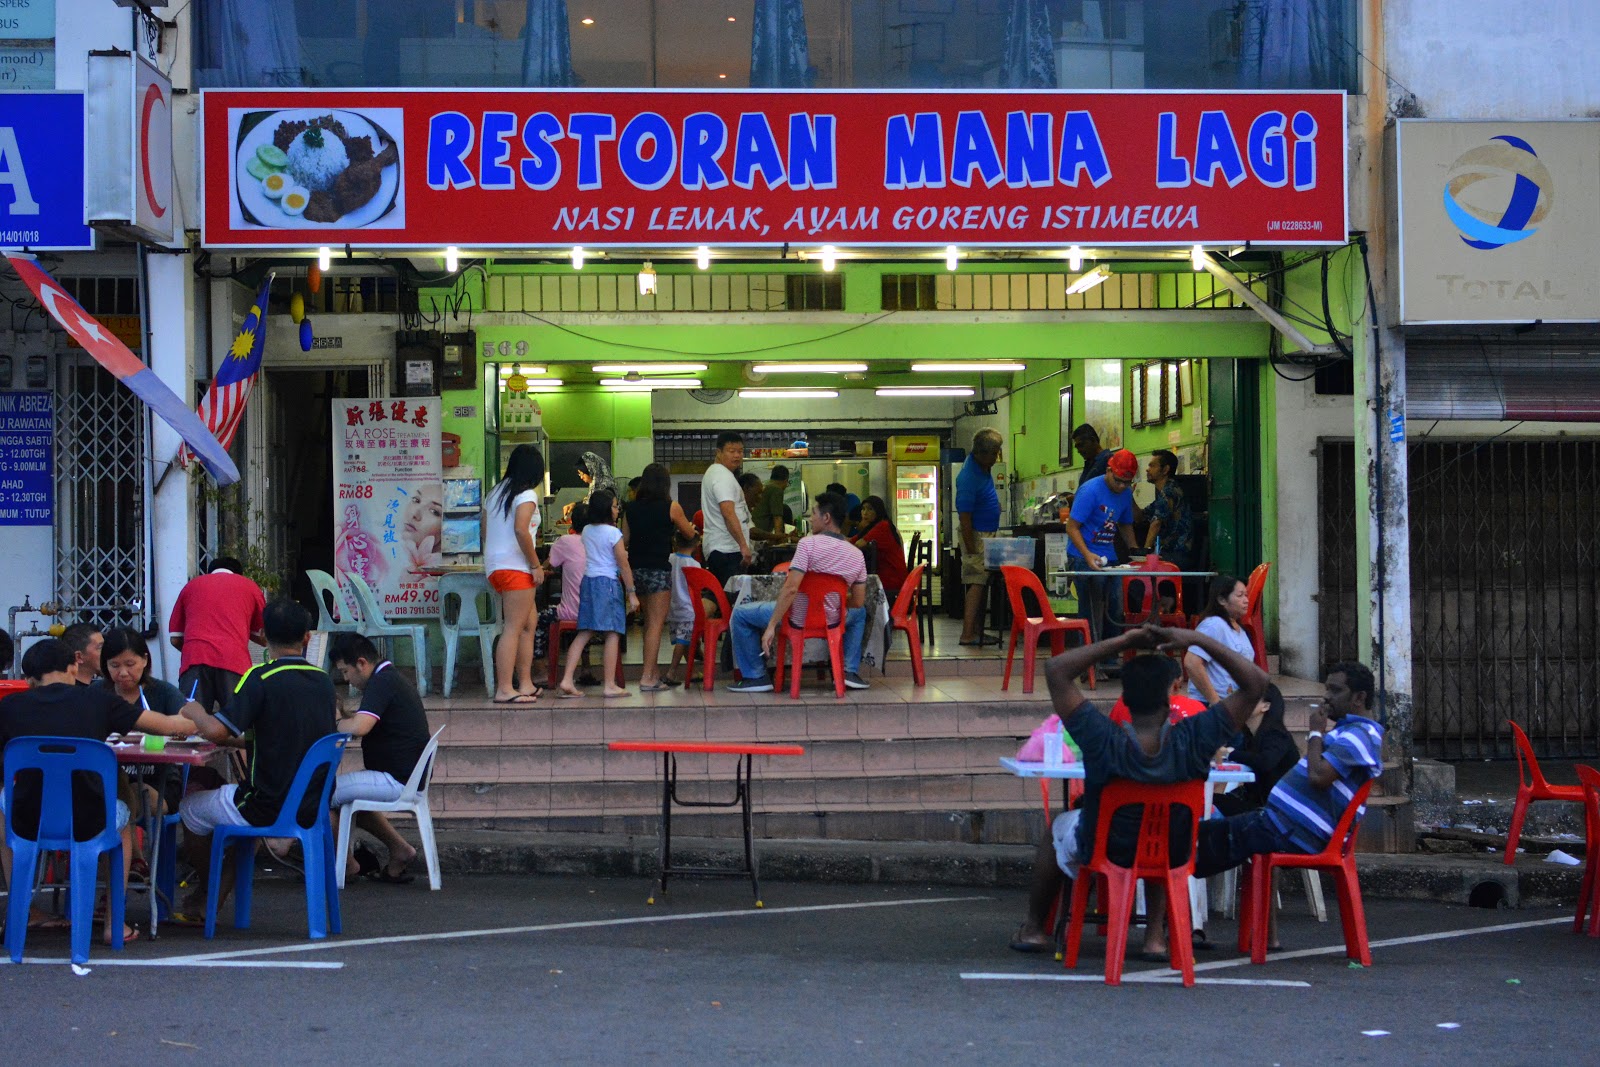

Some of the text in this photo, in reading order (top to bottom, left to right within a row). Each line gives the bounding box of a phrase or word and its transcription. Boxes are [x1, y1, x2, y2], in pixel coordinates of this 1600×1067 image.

[427, 110, 837, 191] RESTORAN
[883, 110, 1113, 190] MANA
[552, 204, 1199, 236] NASI LEMAK, AYAM GORENG ISTIMEWA
[1436, 274, 1568, 300] TOTAL
[7, 417, 52, 429] RAWATAN
[345, 428, 360, 439] LA
[364, 428, 396, 439] ROSE
[25, 436, 52, 446] SABTU
[1, 480, 24, 489] AHAD
[339, 485, 373, 499] RM88
[24, 509, 51, 518] TUTUP
